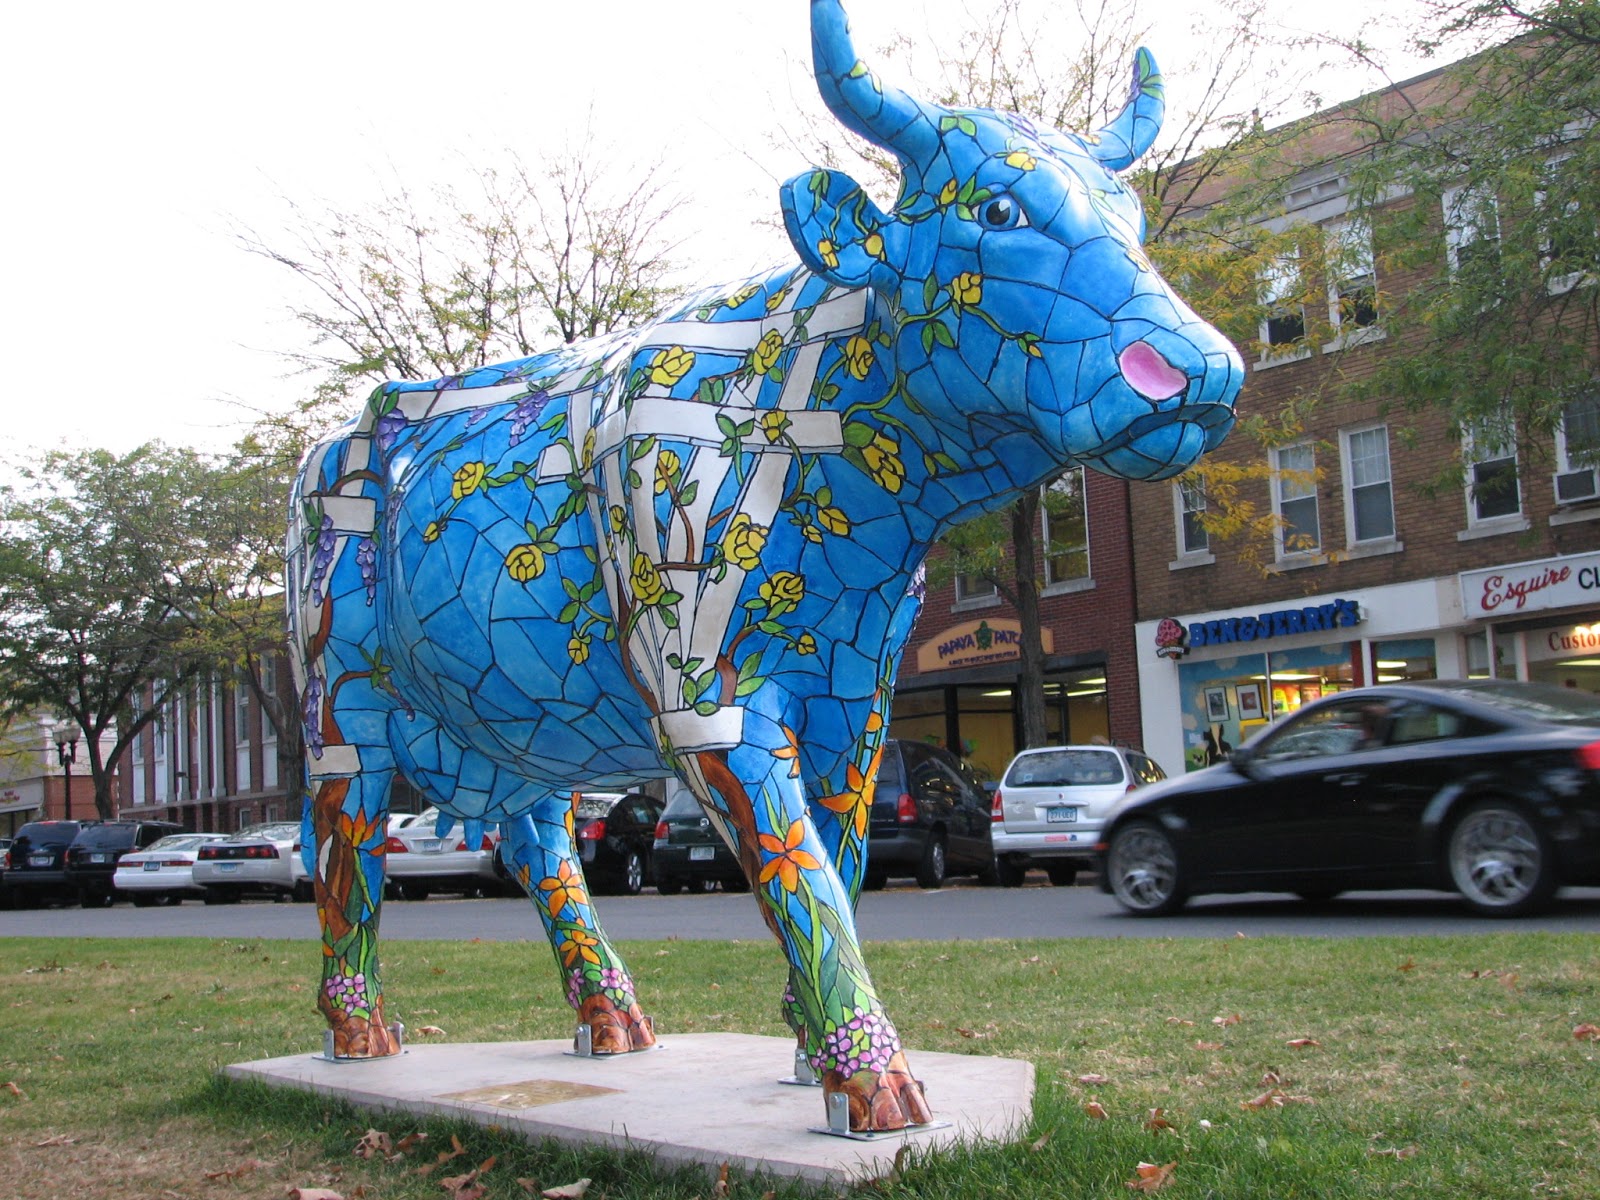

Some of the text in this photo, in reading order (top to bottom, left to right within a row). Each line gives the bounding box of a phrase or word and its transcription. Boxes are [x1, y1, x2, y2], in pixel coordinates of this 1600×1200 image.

[1481, 566, 1572, 611] Esquire
[937, 633, 976, 659] PAPAYA
[994, 629, 1022, 646] PATC
[1548, 631, 1600, 652] Custo
